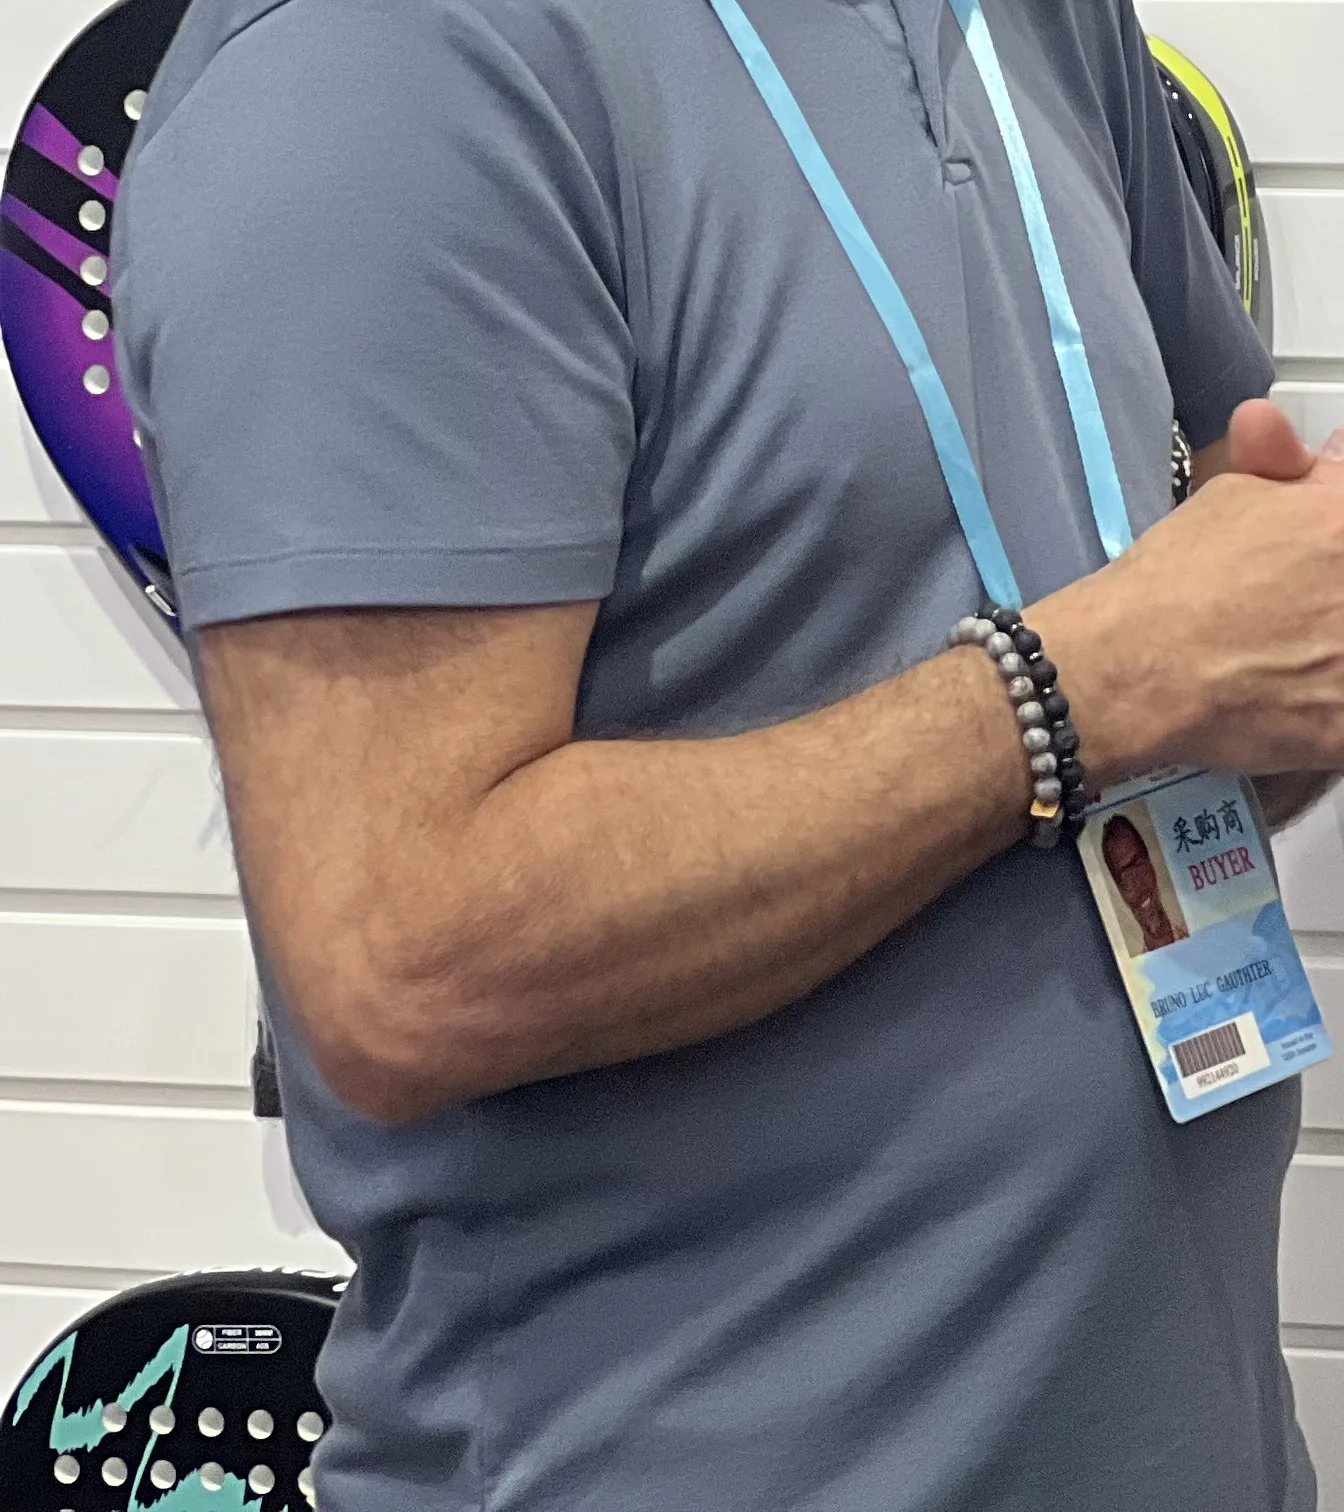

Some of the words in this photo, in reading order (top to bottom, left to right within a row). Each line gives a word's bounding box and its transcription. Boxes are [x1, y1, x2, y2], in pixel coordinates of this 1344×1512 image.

[1172, 799, 1245, 854] 采购商
[1188, 845, 1256, 892] BUYER
[1215, 958, 1273, 993] GAUTHIER
